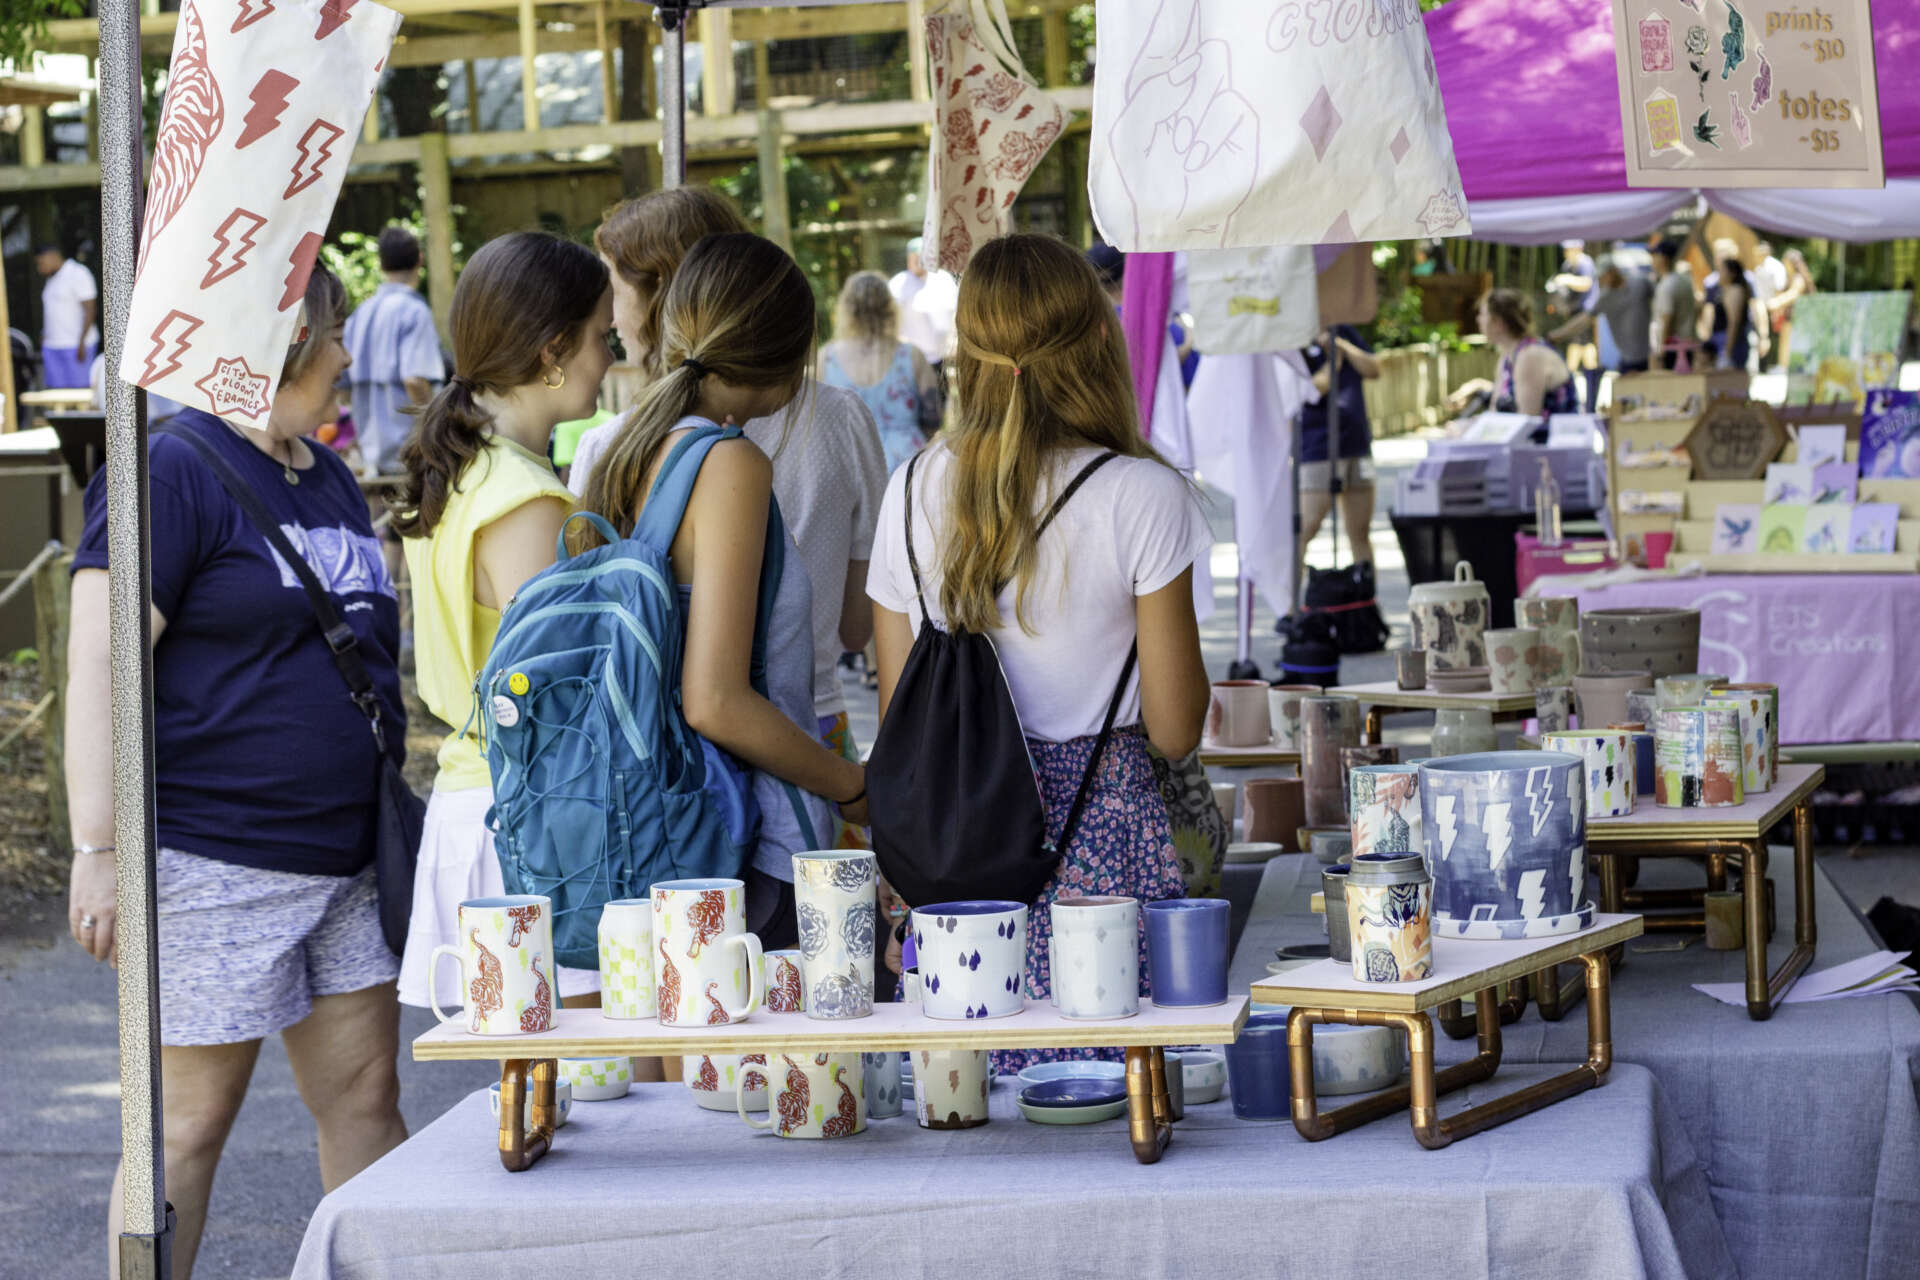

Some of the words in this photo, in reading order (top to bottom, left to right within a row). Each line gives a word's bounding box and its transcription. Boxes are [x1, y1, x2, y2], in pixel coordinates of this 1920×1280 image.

[1765, 5, 1833, 38] prints
[1778, 89, 1851, 121] totes
[221, 366, 245, 380] CITY
[212, 383, 259, 409] CERAMICS
